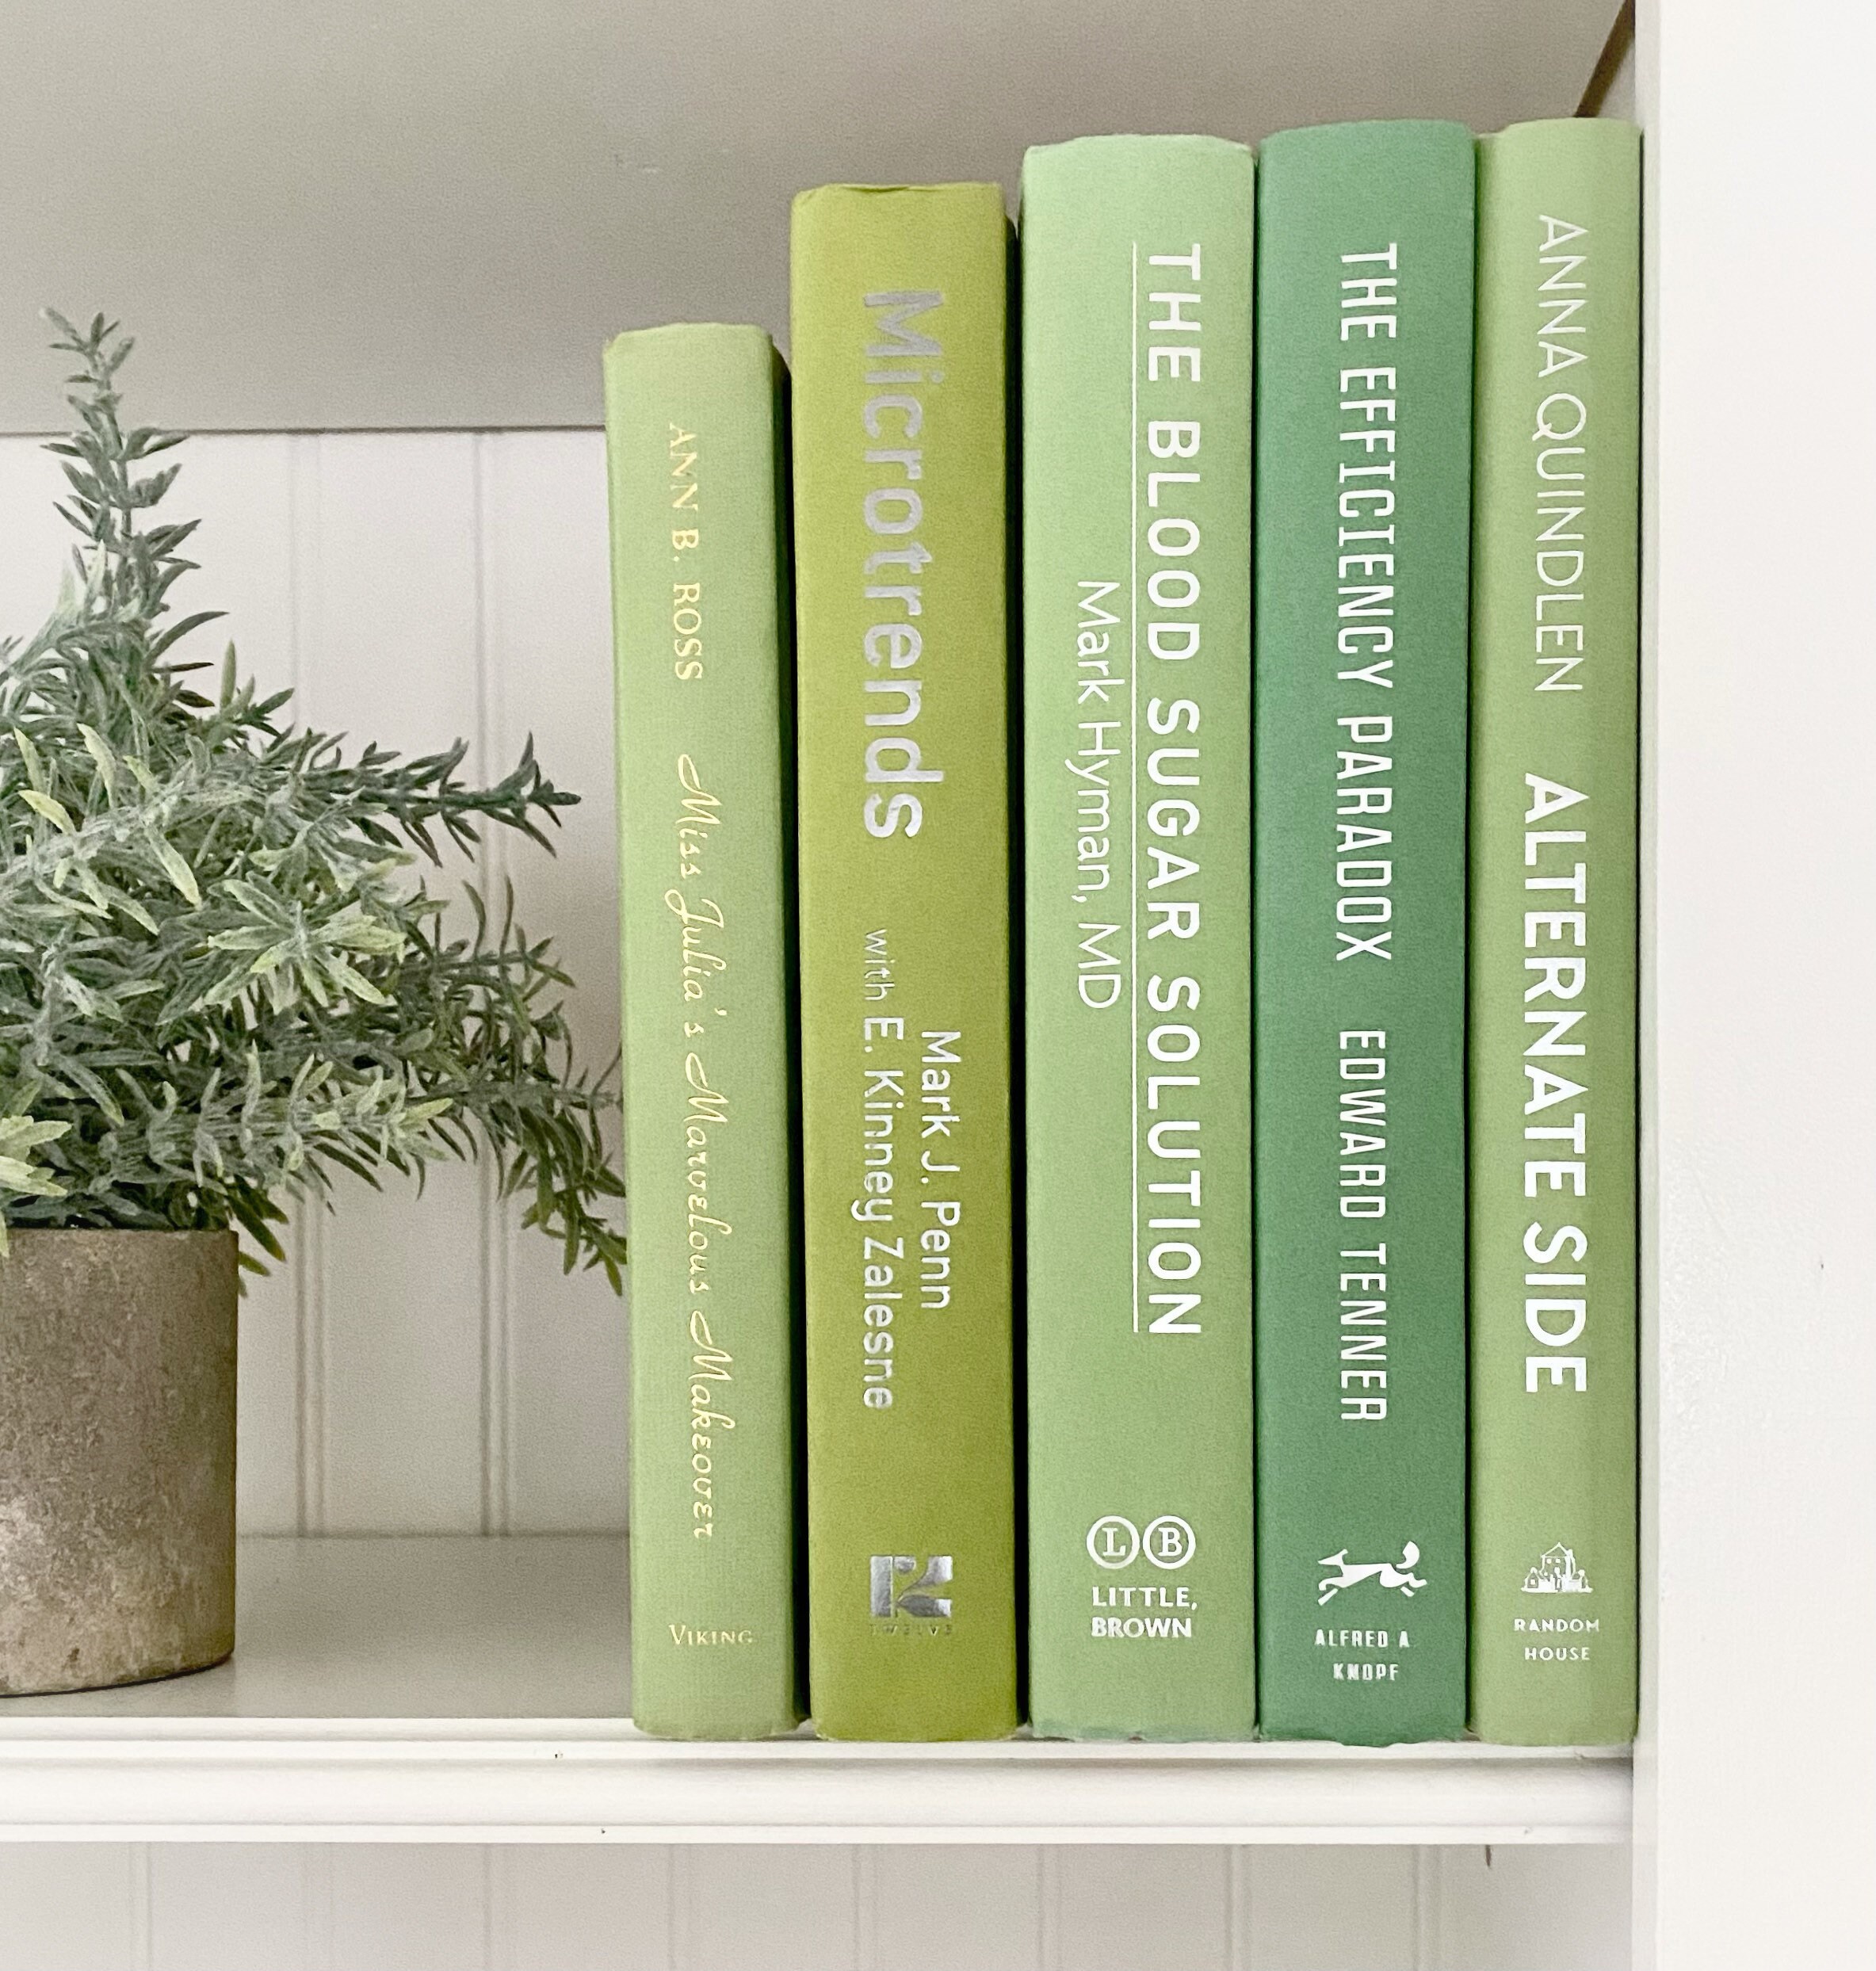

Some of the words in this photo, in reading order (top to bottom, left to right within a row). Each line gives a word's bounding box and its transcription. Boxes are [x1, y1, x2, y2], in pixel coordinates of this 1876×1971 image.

[1148, 243, 1202, 382] THE
[1340, 243, 1397, 342] THE
[1537, 214, 1588, 378] ANNA
[669, 422, 699, 511] ANN
[1337, 367, 1396, 689] EFFICIENCY
[671, 529, 700, 563] B.
[863, 292, 944, 838] Microtrends
[1147, 420, 1201, 660] BLOOD
[1531, 392, 1587, 691] QUINDLEN
[673, 583, 703, 680] ROSS
[1076, 581, 1125, 705] Mark
[675, 754, 722, 879] Miss
[1064, 721, 1121, 903] Hyman,
[1147, 697, 1200, 940] SUGAR
[1335, 716, 1393, 961] PARADOX
[663, 888, 728, 1037] Julia's
[865, 929, 895, 1000] with
[1078, 922, 1121, 1009] MD
[1523, 773, 1589, 1197] ALTERNATE
[863, 1017, 904, 1052] E.
[921, 1031, 961, 1138] Mark
[683, 1052, 732, 1295] Marvelous
[850, 1070, 904, 1221] Kinney
[920, 1151, 961, 1184] J.
[1147, 975, 1202, 1334] SOLUTION
[1339, 1030, 1386, 1218] EDWARD
[863, 1236, 904, 1408] Zalesne
[920, 1201, 961, 1308] Penn
[1523, 1221, 1588, 1393] SIDE
[1339, 1243, 1387, 1420] TENNER
[688, 1310, 735, 1539] Makeover
[1091, 1617, 1192, 1638] BROWN
[1092, 1586, 1198, 1610] LITTLE,
[1315, 1629, 1389, 1648] ALFRED
[1514, 1618, 1599, 1632] RANDOM
[1524, 1647, 1589, 1661] HOUSE
[1333, 1663, 1398, 1681] KNOPF
